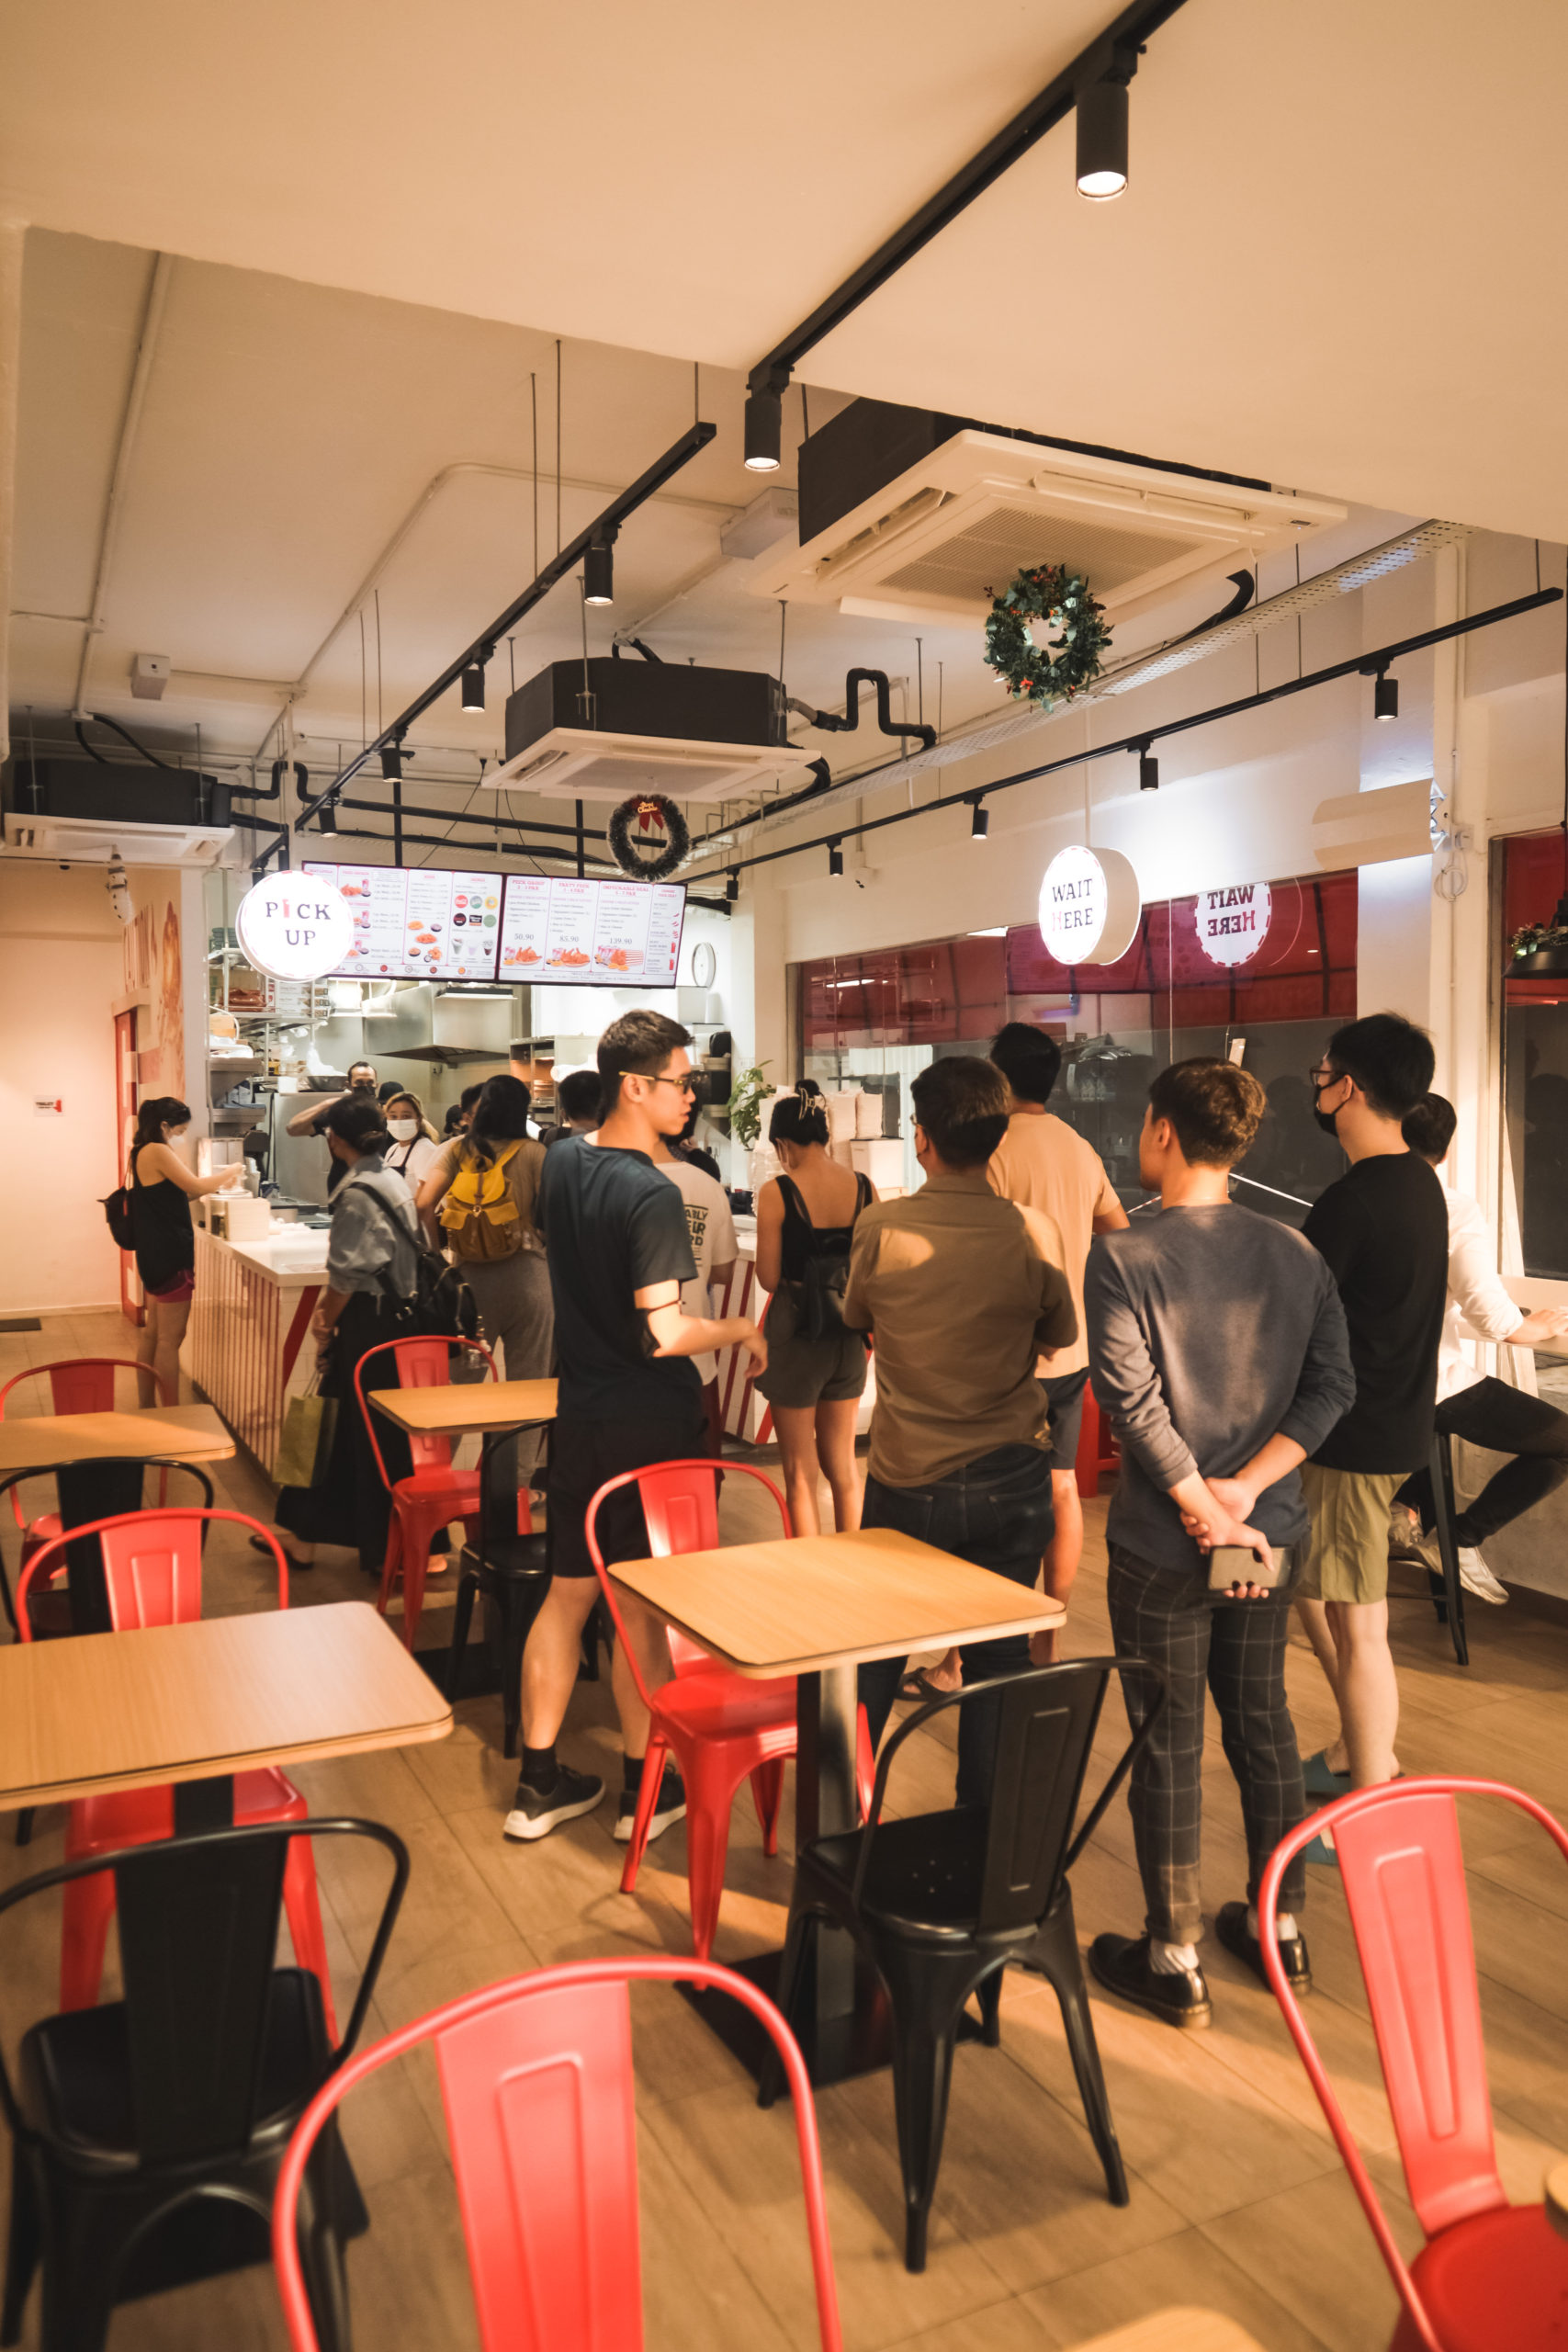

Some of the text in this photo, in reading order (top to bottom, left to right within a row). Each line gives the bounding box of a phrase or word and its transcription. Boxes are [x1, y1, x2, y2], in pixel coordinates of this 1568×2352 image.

[1052, 878, 1093, 902] WAIT
[265, 899, 331, 920] PICK
[1052, 908, 1093, 932] HERE
[285, 930, 316, 945] UP
[514, 933, 535, 941] 50.90
[684, 1209, 708, 1221] ABLY
